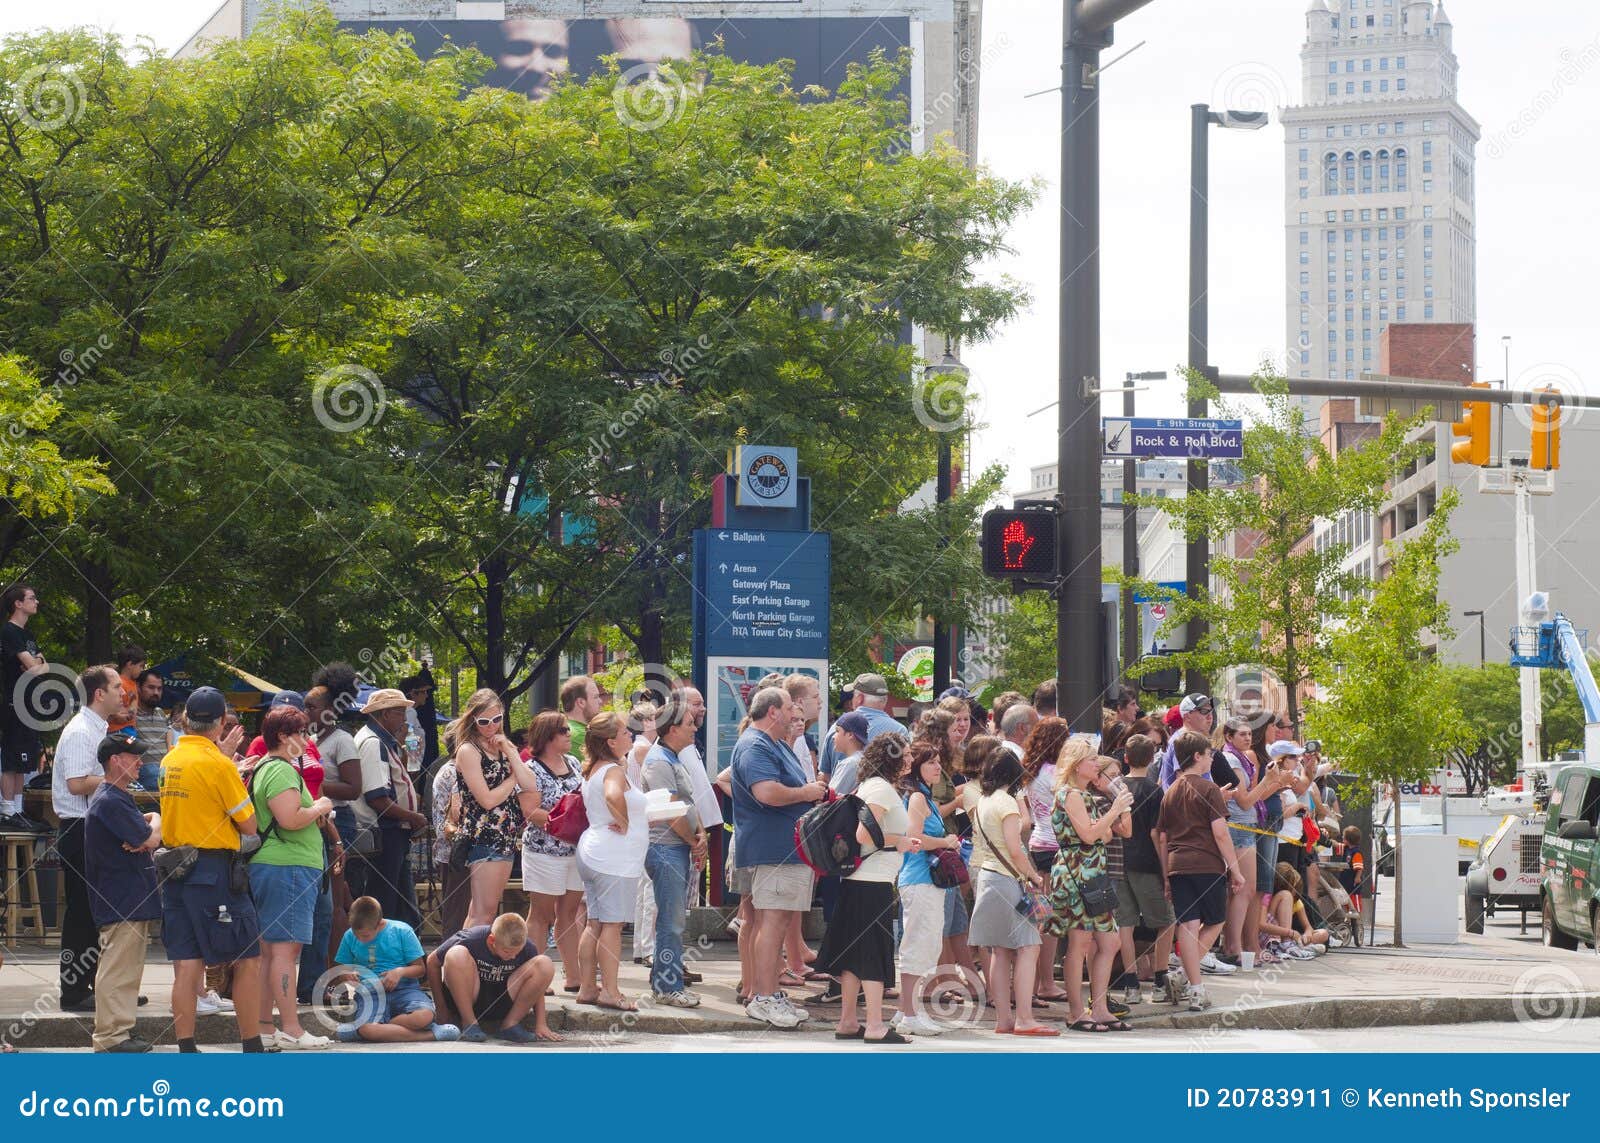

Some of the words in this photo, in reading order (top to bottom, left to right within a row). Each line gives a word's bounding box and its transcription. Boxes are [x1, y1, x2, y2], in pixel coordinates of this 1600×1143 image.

[1188, 420, 1217, 428] Street
[1135, 435, 1165, 446] Rock
[1169, 435, 1179, 446] &
[1184, 436, 1206, 447] Roll
[1210, 437, 1239, 447] Blvd.
[750, 456, 788, 475] GATEWAY
[733, 532, 765, 543] Ballpark
[733, 563, 757, 573] Arena
[732, 579, 767, 591] Gateway
[770, 580, 791, 590] Plaza
[732, 595, 749, 604] East
[752, 596, 782, 607] Parking
[784, 596, 810, 608] Garage
[732, 611, 755, 620] North
[757, 612, 787, 623] Parking
[789, 613, 815, 624] Garage
[732, 627, 748, 637] RTA
[751, 627, 775, 637] Tower
[777, 627, 793, 638] City
[795, 629, 822, 638] Station
